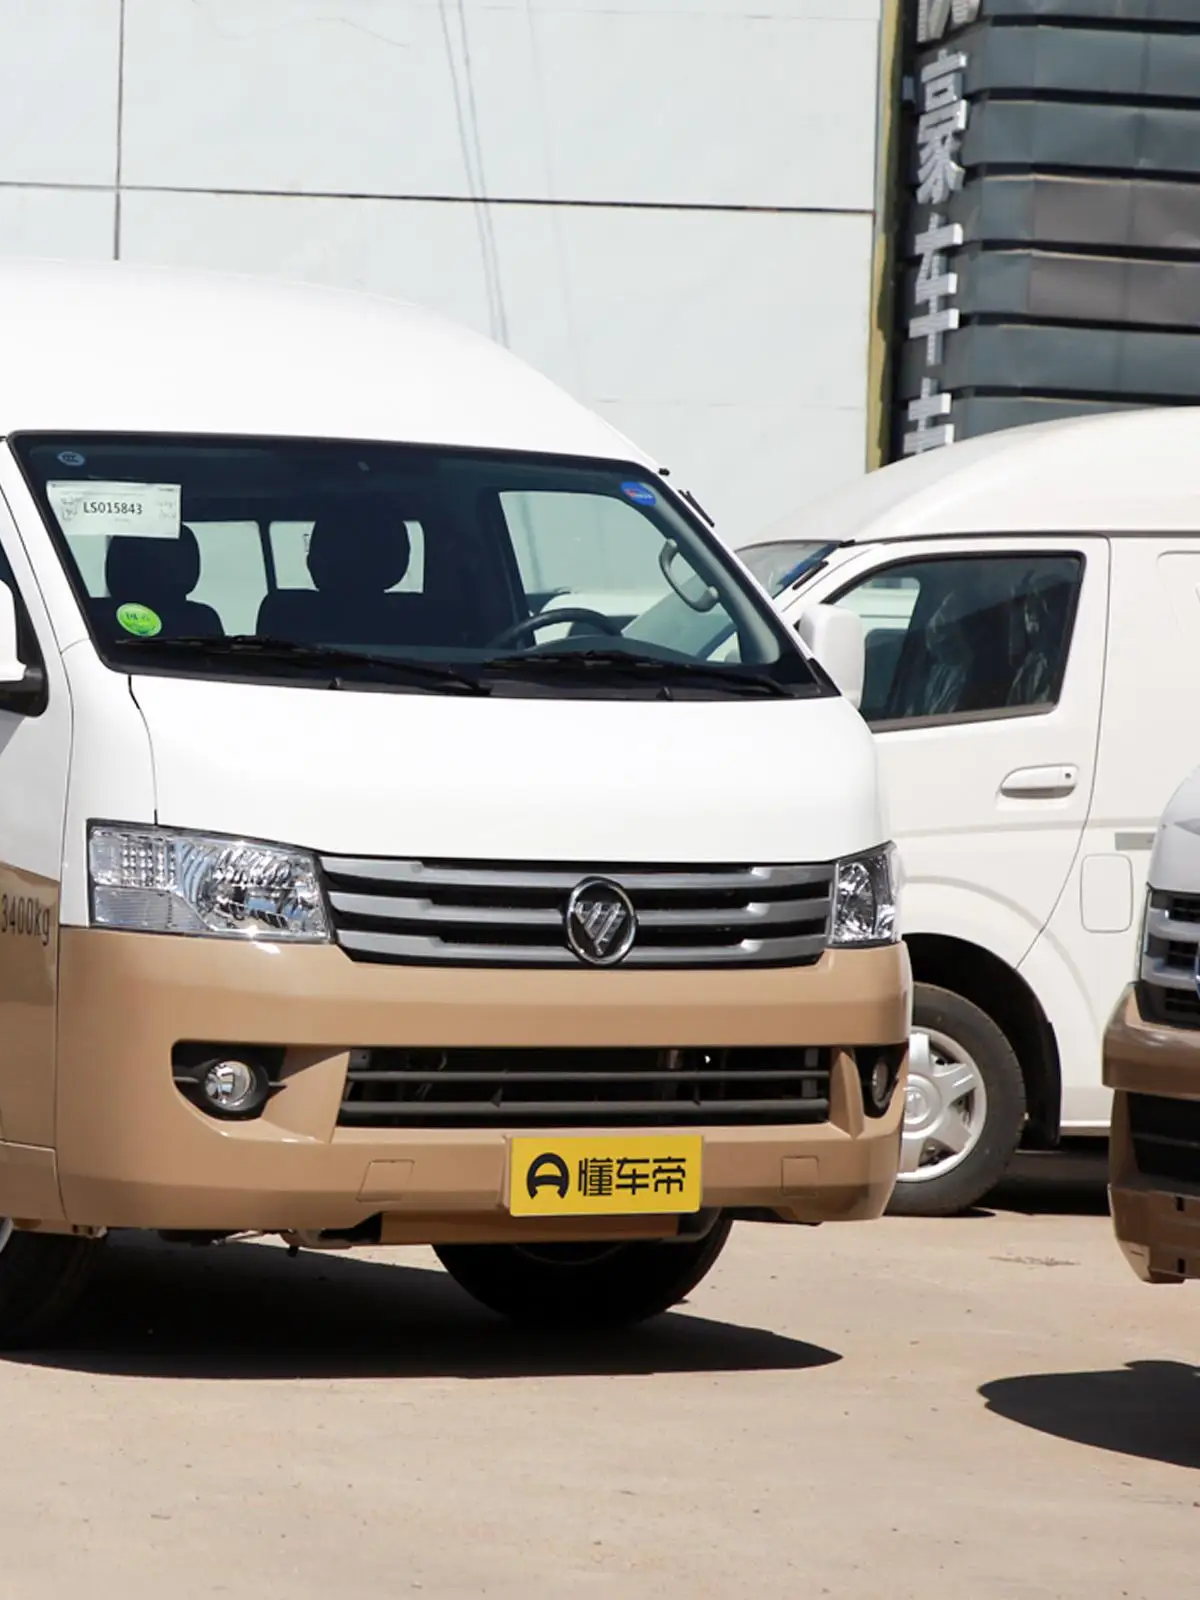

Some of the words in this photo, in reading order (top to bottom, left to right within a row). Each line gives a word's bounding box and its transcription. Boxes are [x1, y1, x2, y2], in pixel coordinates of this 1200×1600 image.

[82, 501, 144, 515] LS015843
[577, 1156, 687, 1197] 懂车帝
